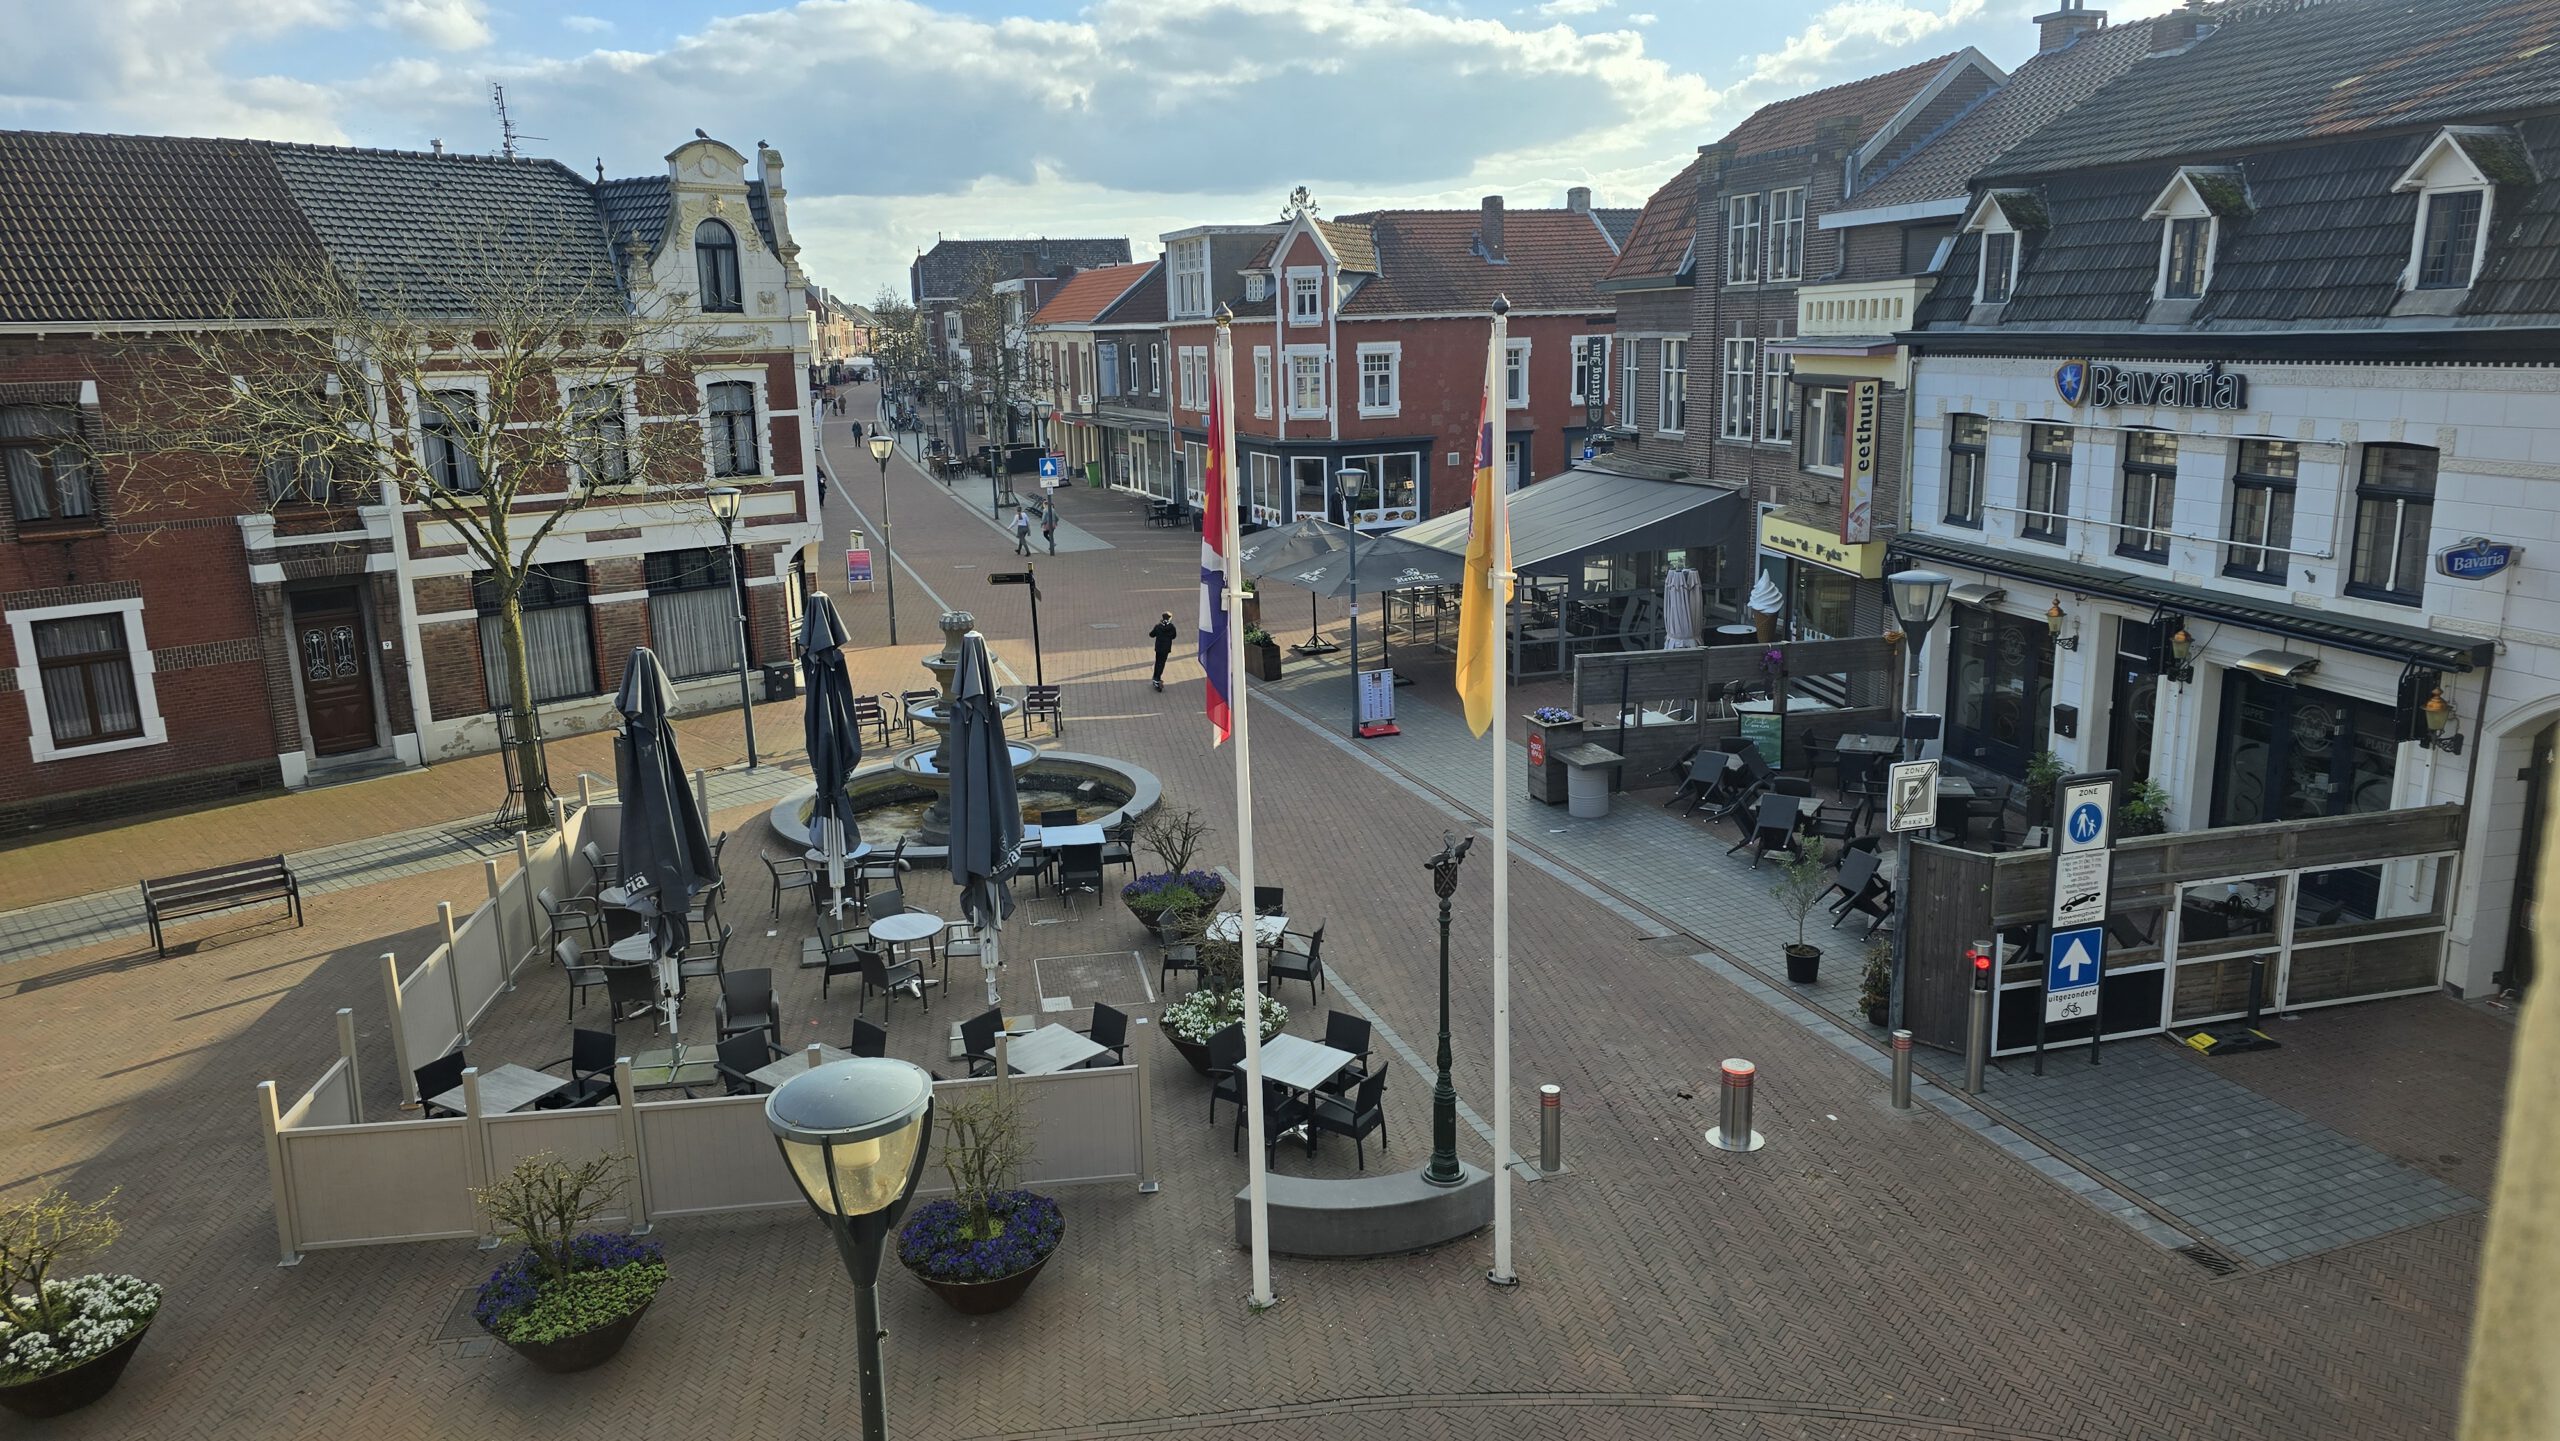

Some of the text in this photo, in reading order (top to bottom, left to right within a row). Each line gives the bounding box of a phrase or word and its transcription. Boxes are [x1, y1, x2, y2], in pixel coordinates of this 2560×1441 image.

[1589, 344, 1604, 406] Hertog Jan
[2089, 362, 2246, 410] Bavaria
[1857, 384, 1875, 472] eethuis
[2453, 552, 2504, 571] Bavaria
[2064, 725, 2070, 734] 5
[2365, 738, 2392, 752] PLATZ
[1904, 766, 1925, 775] ZONE
[2078, 787, 2098, 796] ZONE
[2048, 988, 2097, 1003] uitgezonderd
